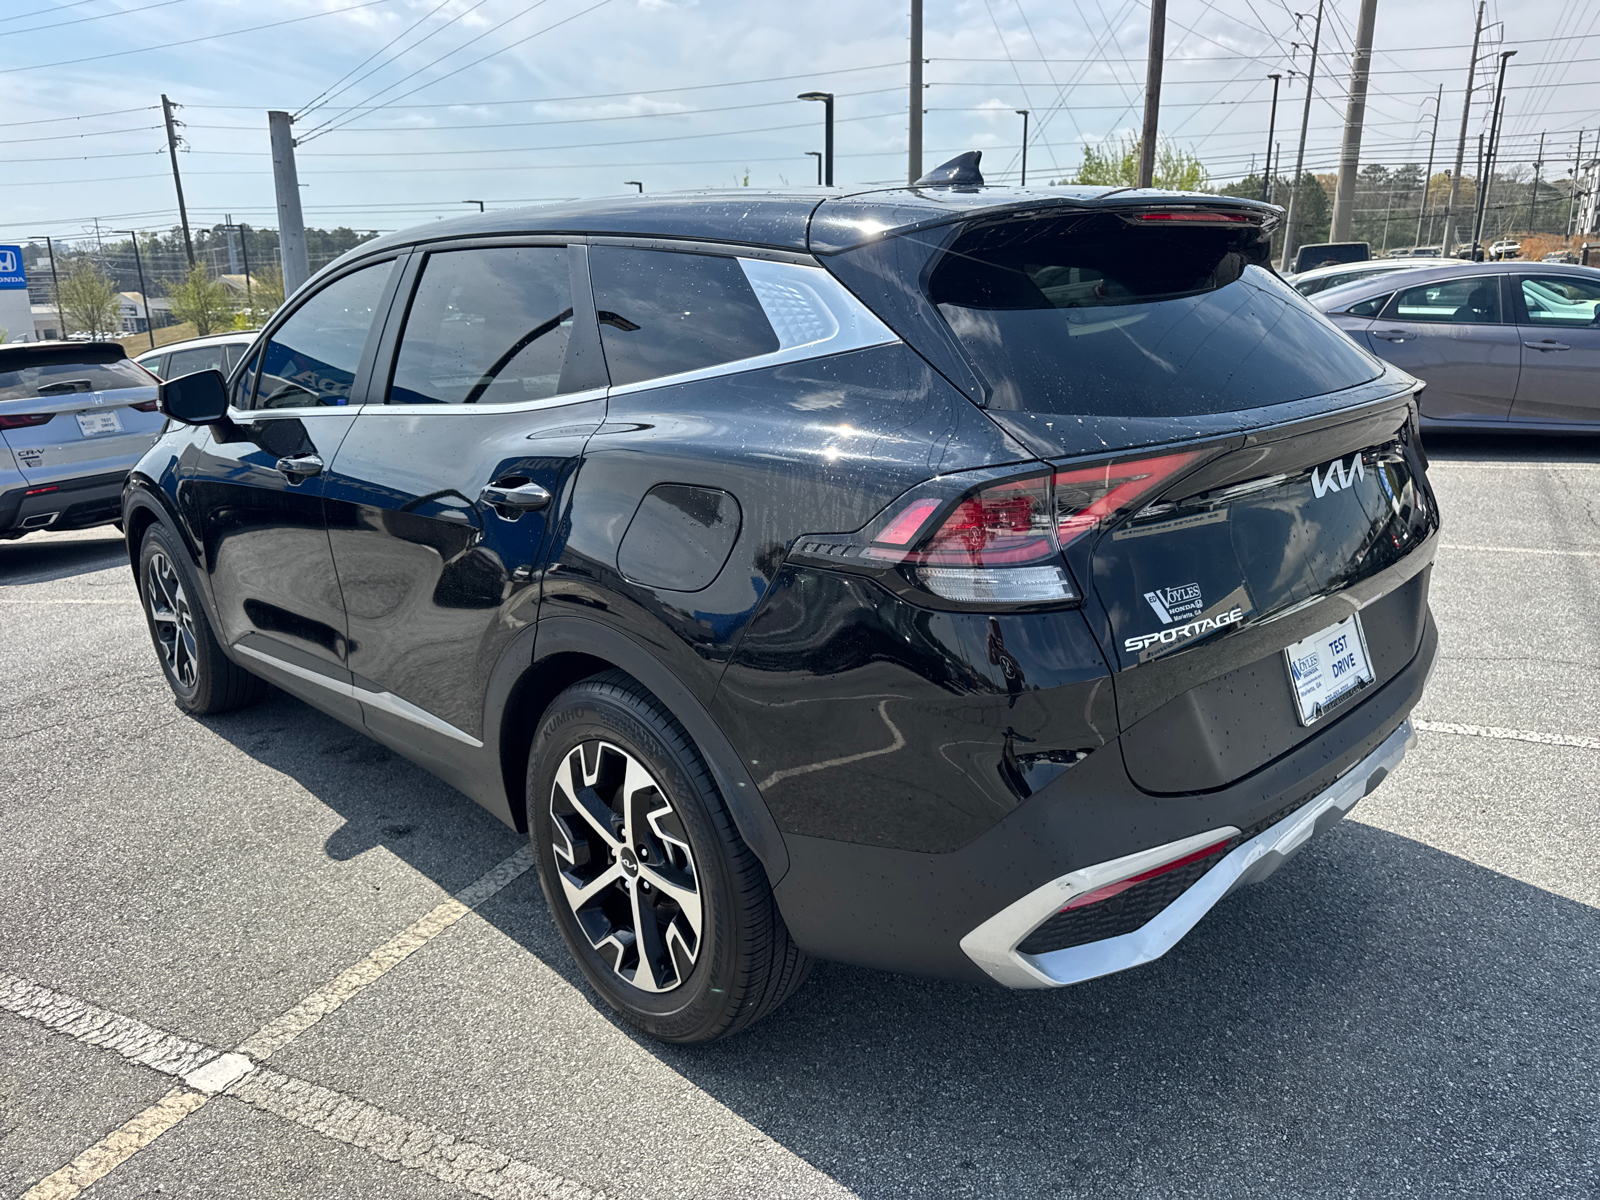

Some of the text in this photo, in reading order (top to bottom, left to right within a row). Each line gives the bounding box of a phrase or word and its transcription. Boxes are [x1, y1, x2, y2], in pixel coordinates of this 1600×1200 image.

[1311, 453, 1364, 499] KIA
[1148, 595, 1157, 603] ED
[1156, 585, 1200, 609] VOYLES
[1169, 604, 1196, 614] HONDA
[1124, 607, 1243, 652] SPORTAGE
[1329, 634, 1348, 656] TEST
[1332, 653, 1356, 678] DRIVE
[543, 706, 584, 741] KUMHO
